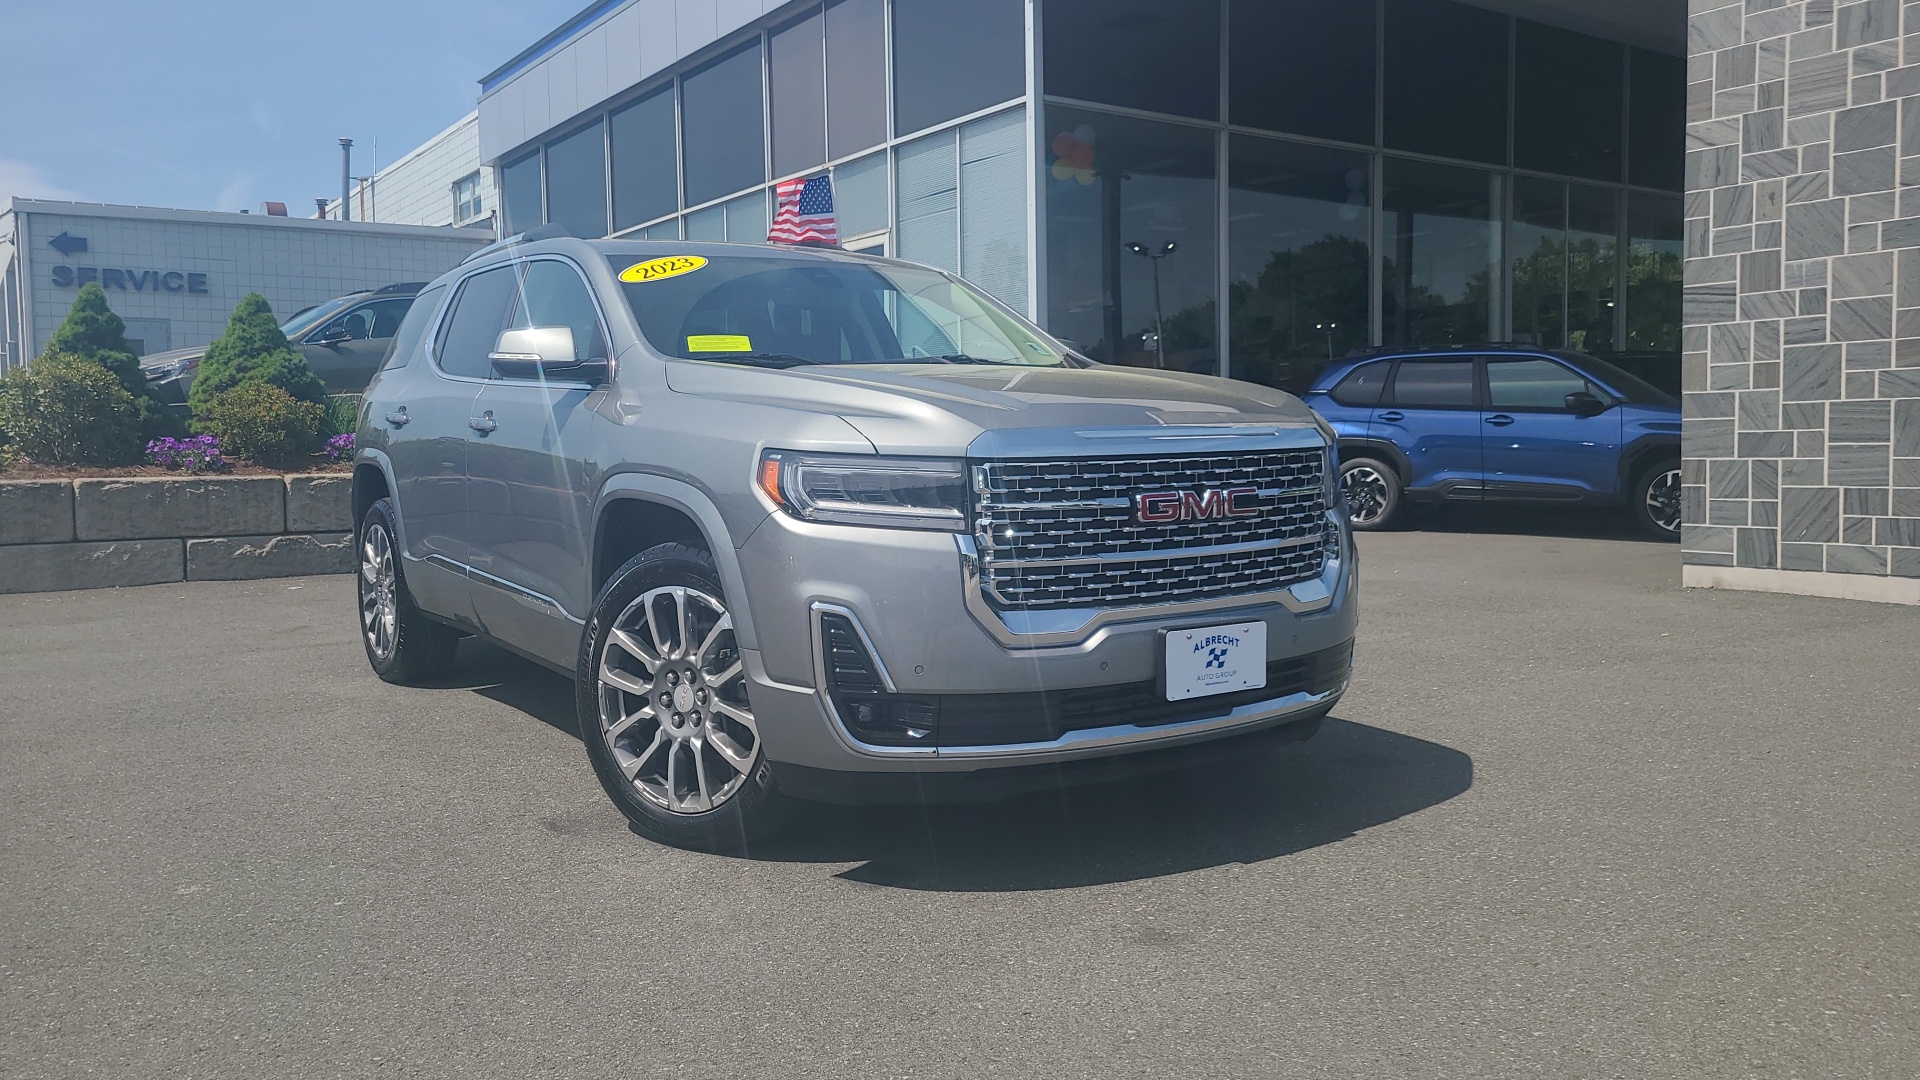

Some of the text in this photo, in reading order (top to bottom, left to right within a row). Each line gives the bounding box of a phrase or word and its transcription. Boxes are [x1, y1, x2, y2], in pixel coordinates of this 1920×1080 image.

[635, 258, 695, 279] 2023
[51, 265, 209, 294] SERVICE
[1136, 486, 1259, 523] GMC
[1193, 635, 1240, 654] ALBRECHT
[1196, 670, 1238, 681] AUTO GROUP
